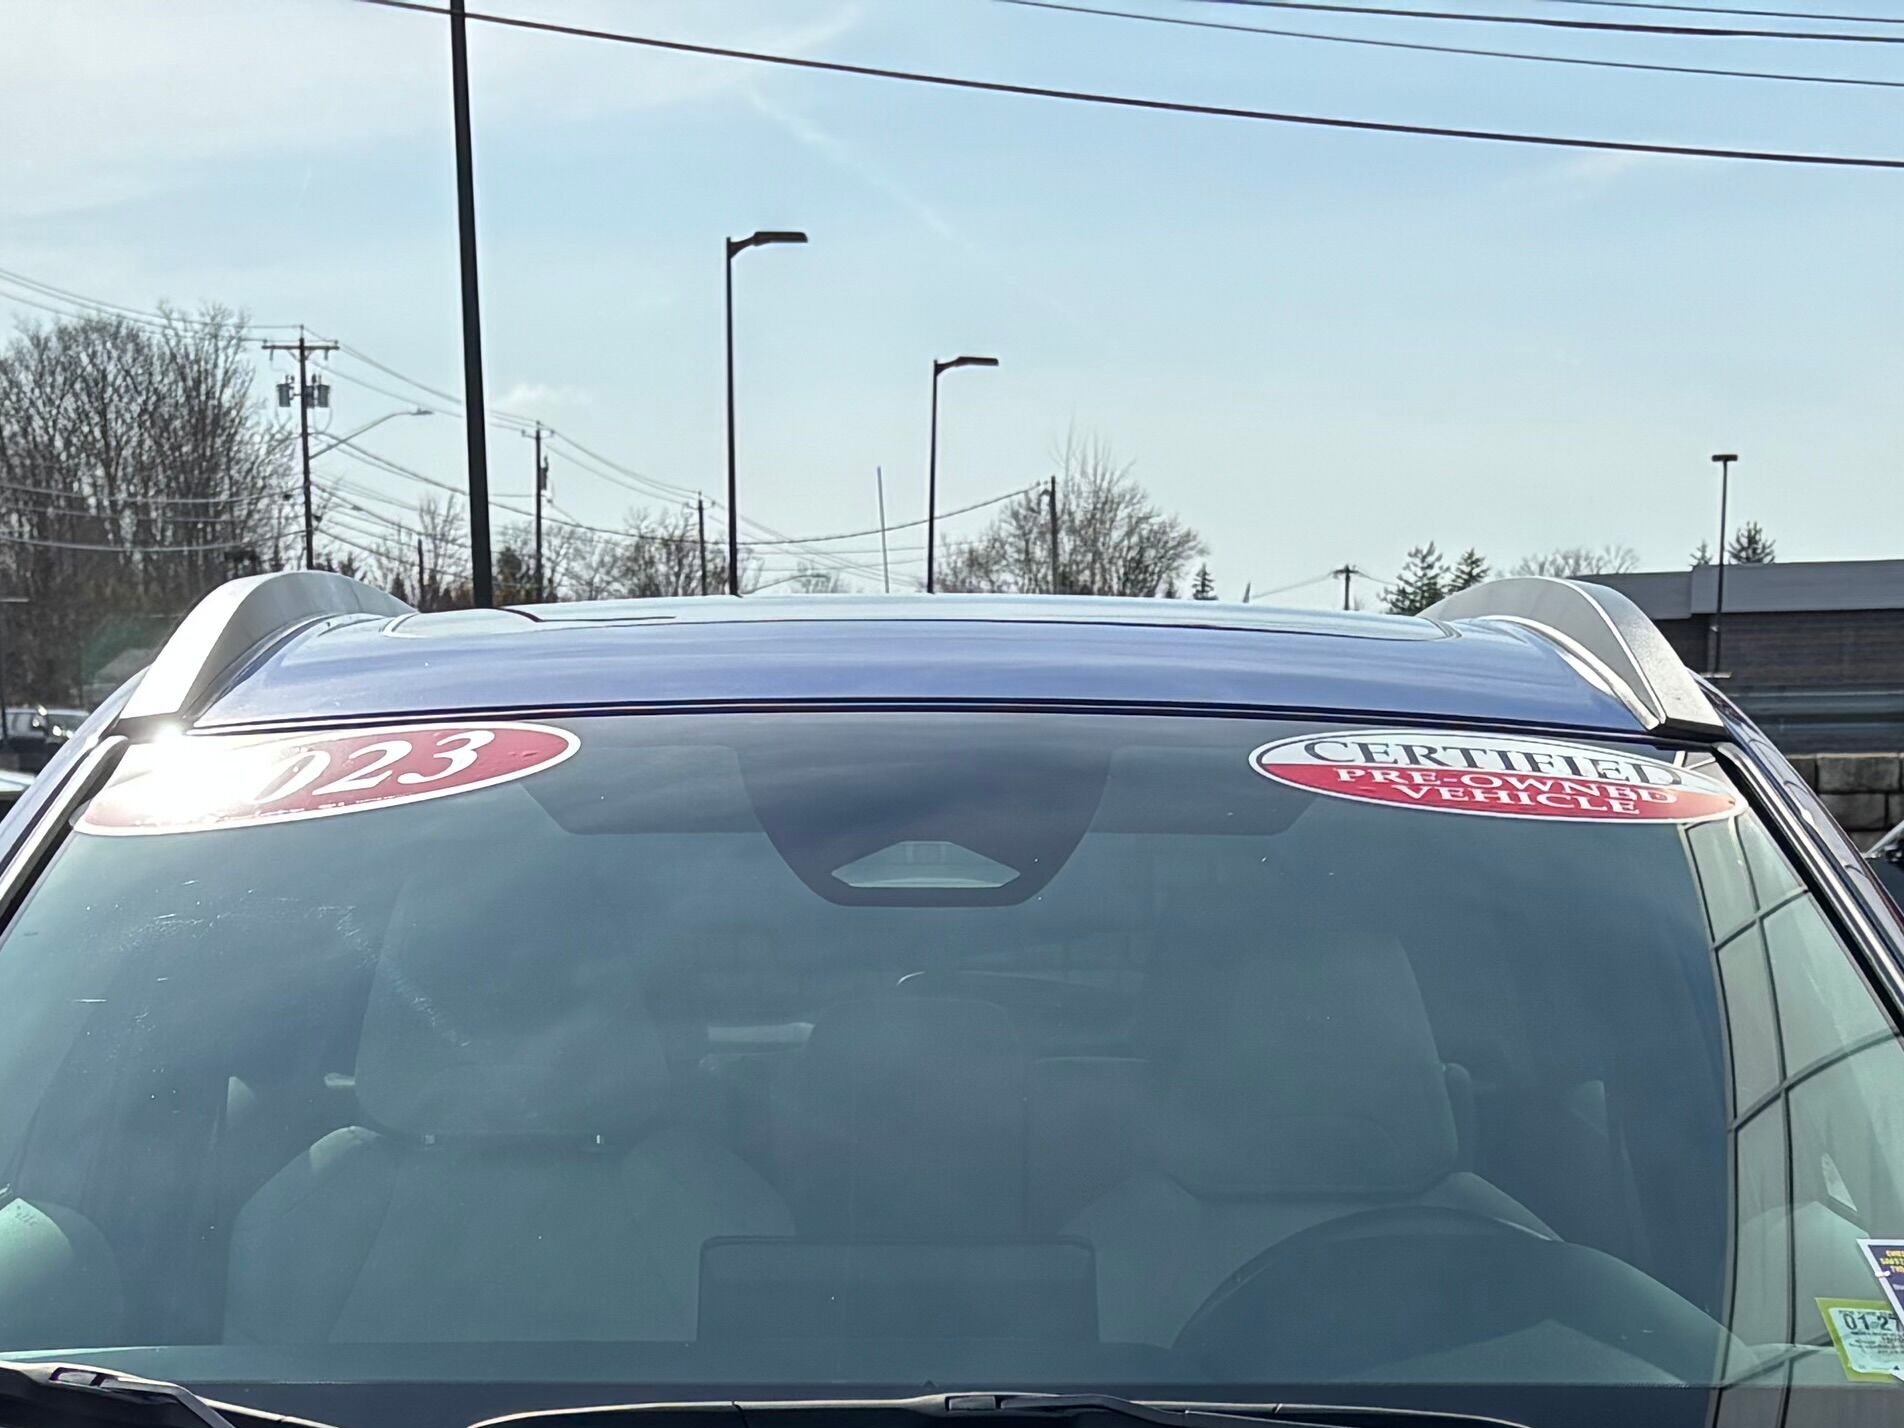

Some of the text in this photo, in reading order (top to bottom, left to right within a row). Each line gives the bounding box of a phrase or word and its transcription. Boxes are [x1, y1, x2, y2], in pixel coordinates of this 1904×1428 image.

[236, 729, 496, 804] 023
[1304, 741, 1683, 786] CERTIFIED
[1332, 767, 1678, 804] PRE-OWNED
[1391, 785, 1641, 815] VEHICLE
